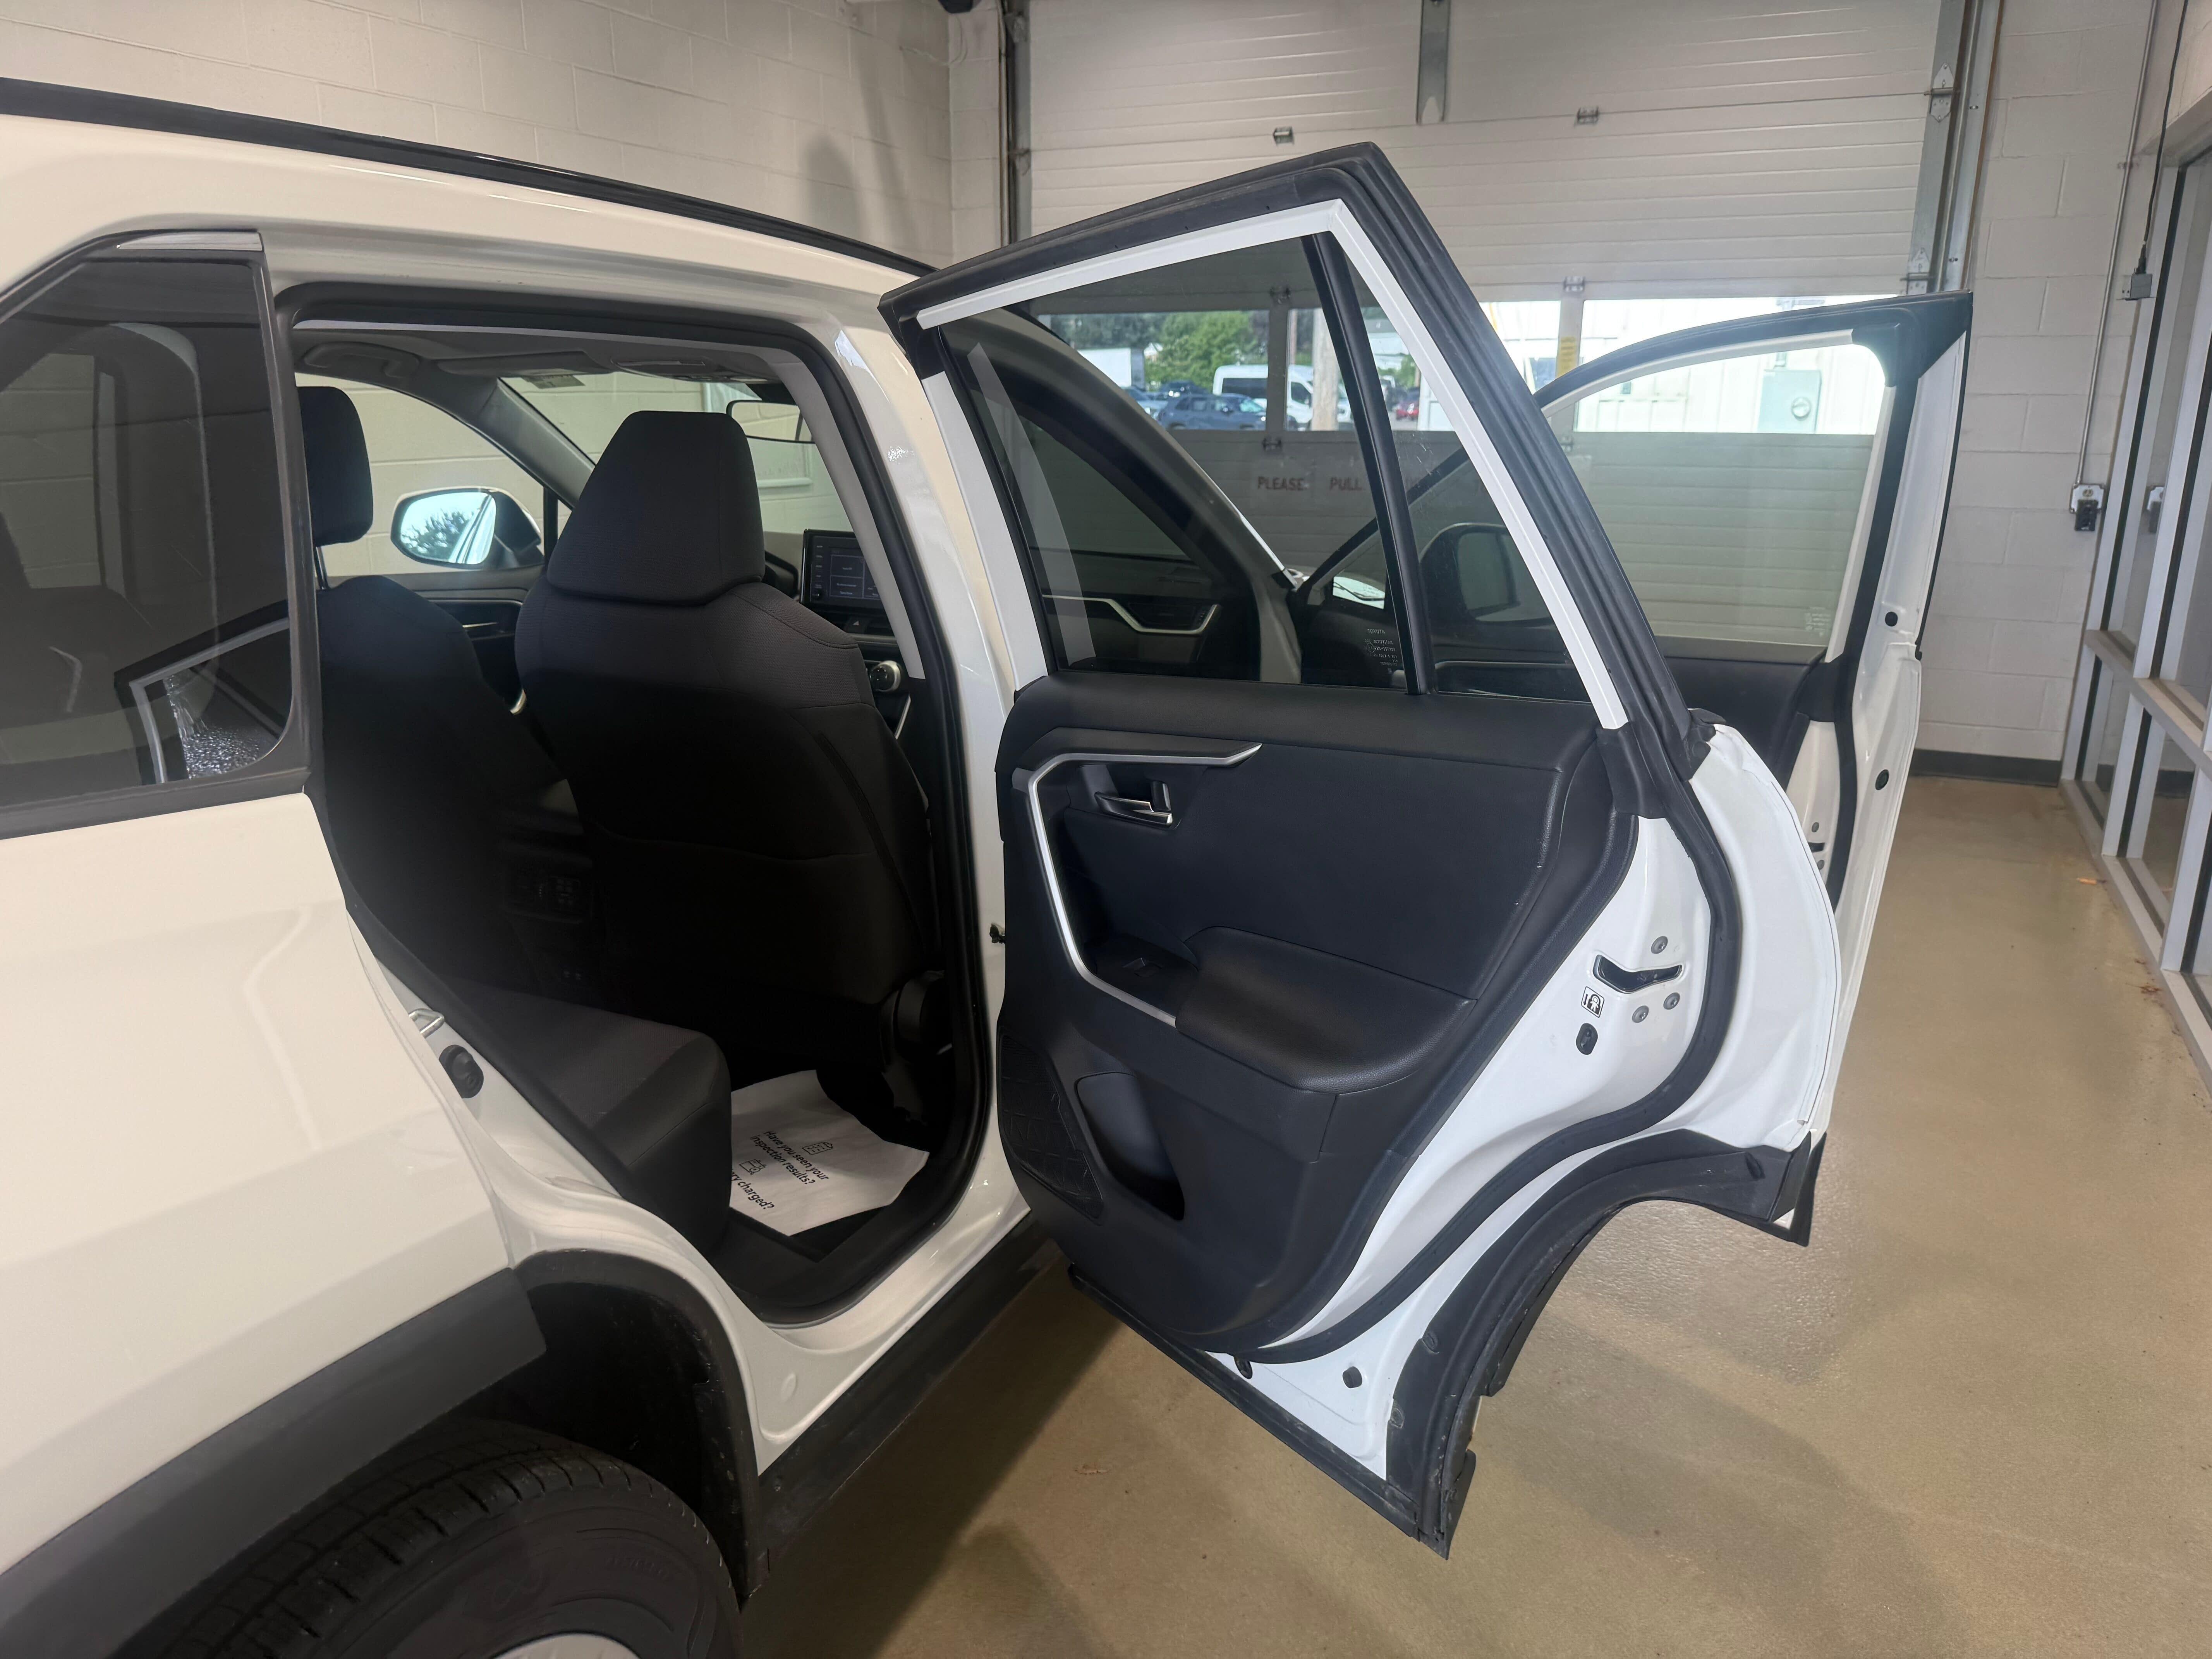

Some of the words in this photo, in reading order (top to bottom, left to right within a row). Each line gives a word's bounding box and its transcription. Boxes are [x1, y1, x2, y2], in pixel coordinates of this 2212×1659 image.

[1257, 476, 1305, 491] PLEASE
[1329, 477, 1363, 491] PULL
[750, 1135, 787, 1162] inspection
[782, 1163, 816, 1184] results?
[763, 1131, 783, 1145] Have
[777, 1145, 797, 1154] you
[792, 1154, 812, 1168] seen
[805, 1168, 829, 1180] your
[738, 1182, 775, 1209] charged?
